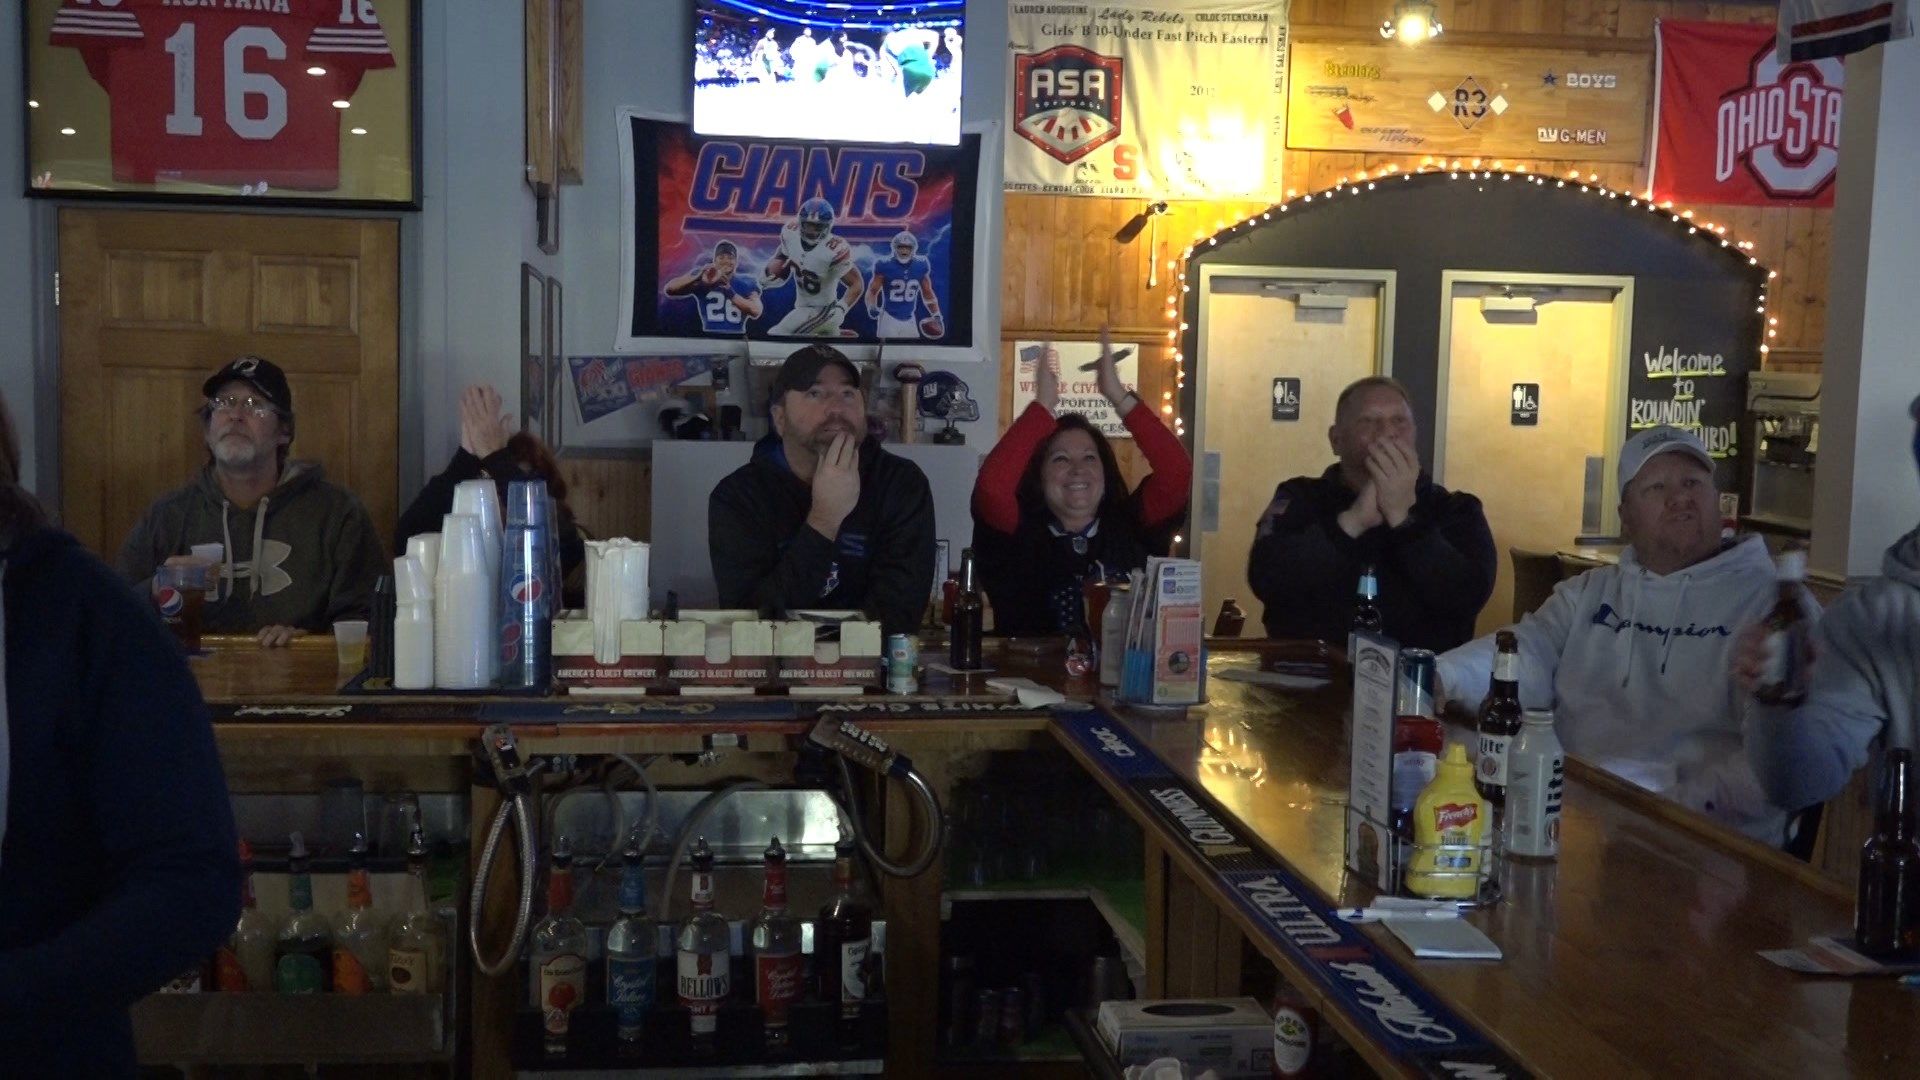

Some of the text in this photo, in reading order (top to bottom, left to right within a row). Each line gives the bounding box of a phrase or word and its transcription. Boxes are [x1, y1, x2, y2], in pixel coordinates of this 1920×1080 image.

[1041, 24, 1077, 36] Girls'
[1096, 25, 1153, 40] 10-Under
[1157, 29, 1182, 42] Fast
[1186, 31, 1218, 43] Pitch
[1221, 33, 1269, 44] Eastern
[165, 22, 287, 139] 16
[1031, 69, 1105, 100] ASA
[1566, 73, 1616, 88] BOYS
[1454, 88, 1487, 118] R3
[1560, 129, 1607, 144] G-MEN
[1715, 86, 1785, 183] OHIO
[688, 140, 926, 222] GIANTS
[705, 290, 742, 323] 26
[1643, 345, 1726, 376] Welcome
[1673, 377, 1695, 399] to
[1631, 397, 1706, 425] ROUNDIN'
[1692, 421, 1738, 457] HIRD!
[1237, 875, 1342, 946] ULTRA
[680, 975, 729, 998] BELLOWS
